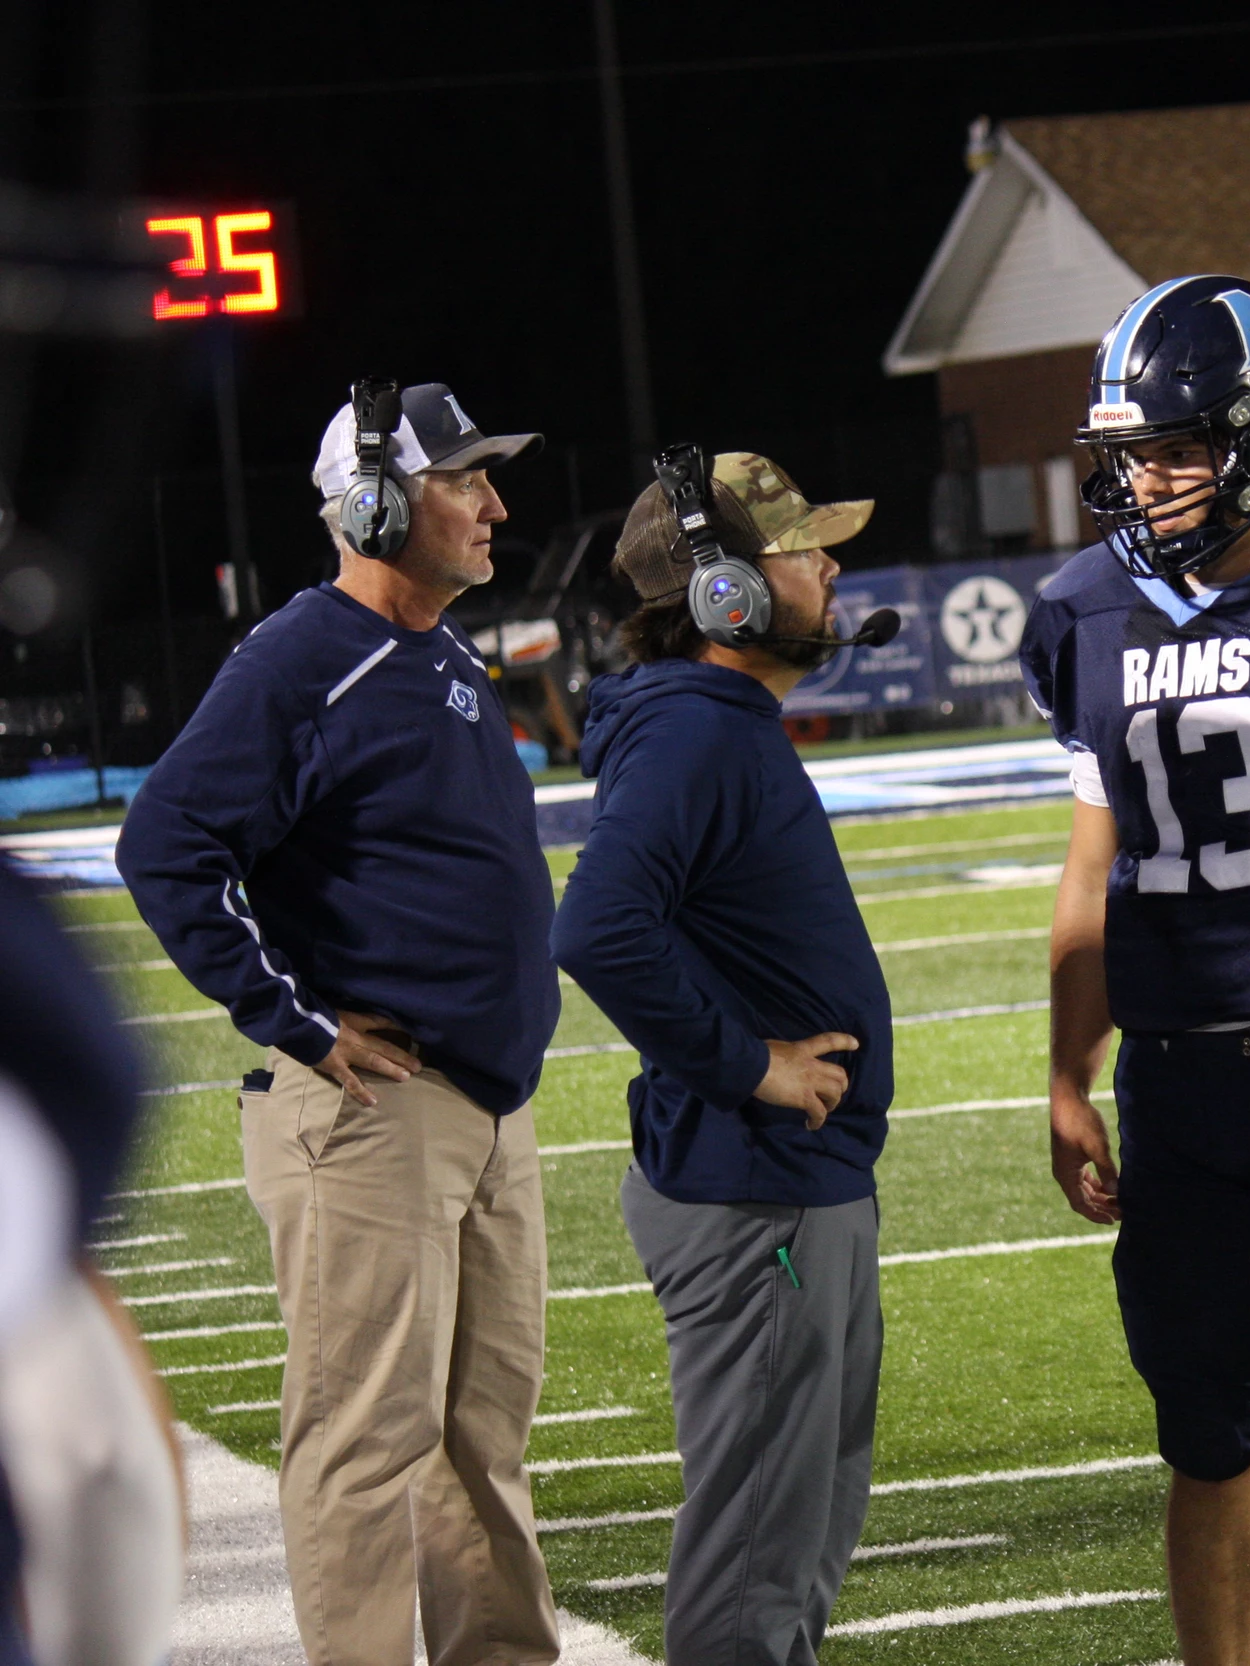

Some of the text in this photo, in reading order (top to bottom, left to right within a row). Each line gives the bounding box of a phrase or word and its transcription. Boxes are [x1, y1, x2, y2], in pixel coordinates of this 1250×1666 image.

[147, 211, 278, 320] 25
[1093, 410, 1133, 421] Riddell
[946, 659, 1024, 689] TEXAC
